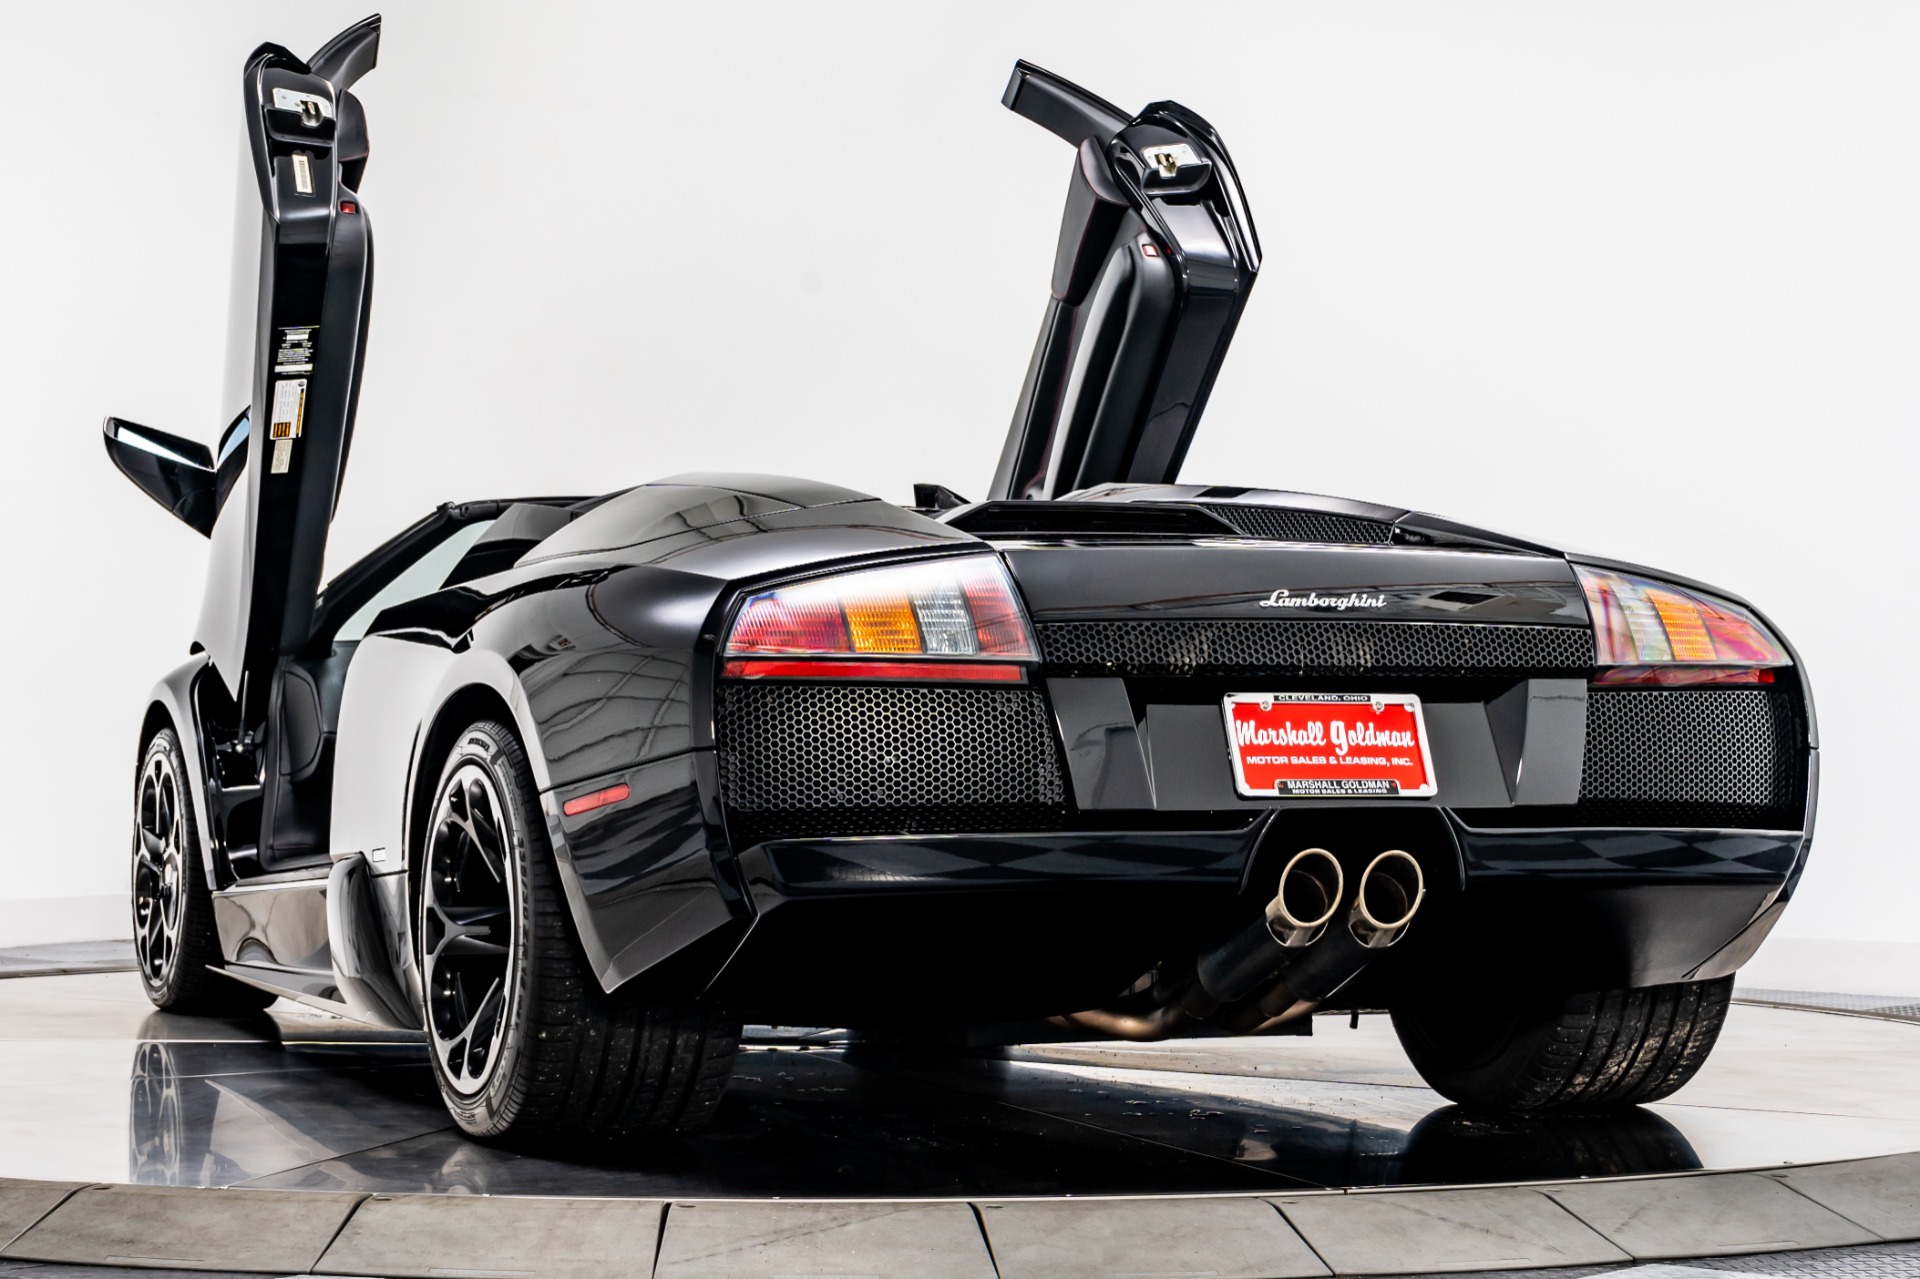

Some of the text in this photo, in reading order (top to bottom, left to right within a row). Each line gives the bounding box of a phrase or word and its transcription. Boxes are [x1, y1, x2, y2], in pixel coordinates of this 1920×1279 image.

[1259, 589, 1387, 610] Lamborghini
[1343, 694, 1368, 702] OHIO
[1235, 720, 1415, 756] Marshall Goldman
[1246, 756, 1414, 767] MOTOR SALES & LEASING, INC.
[1287, 780, 1390, 789] MARSHALL GOLDMAN
